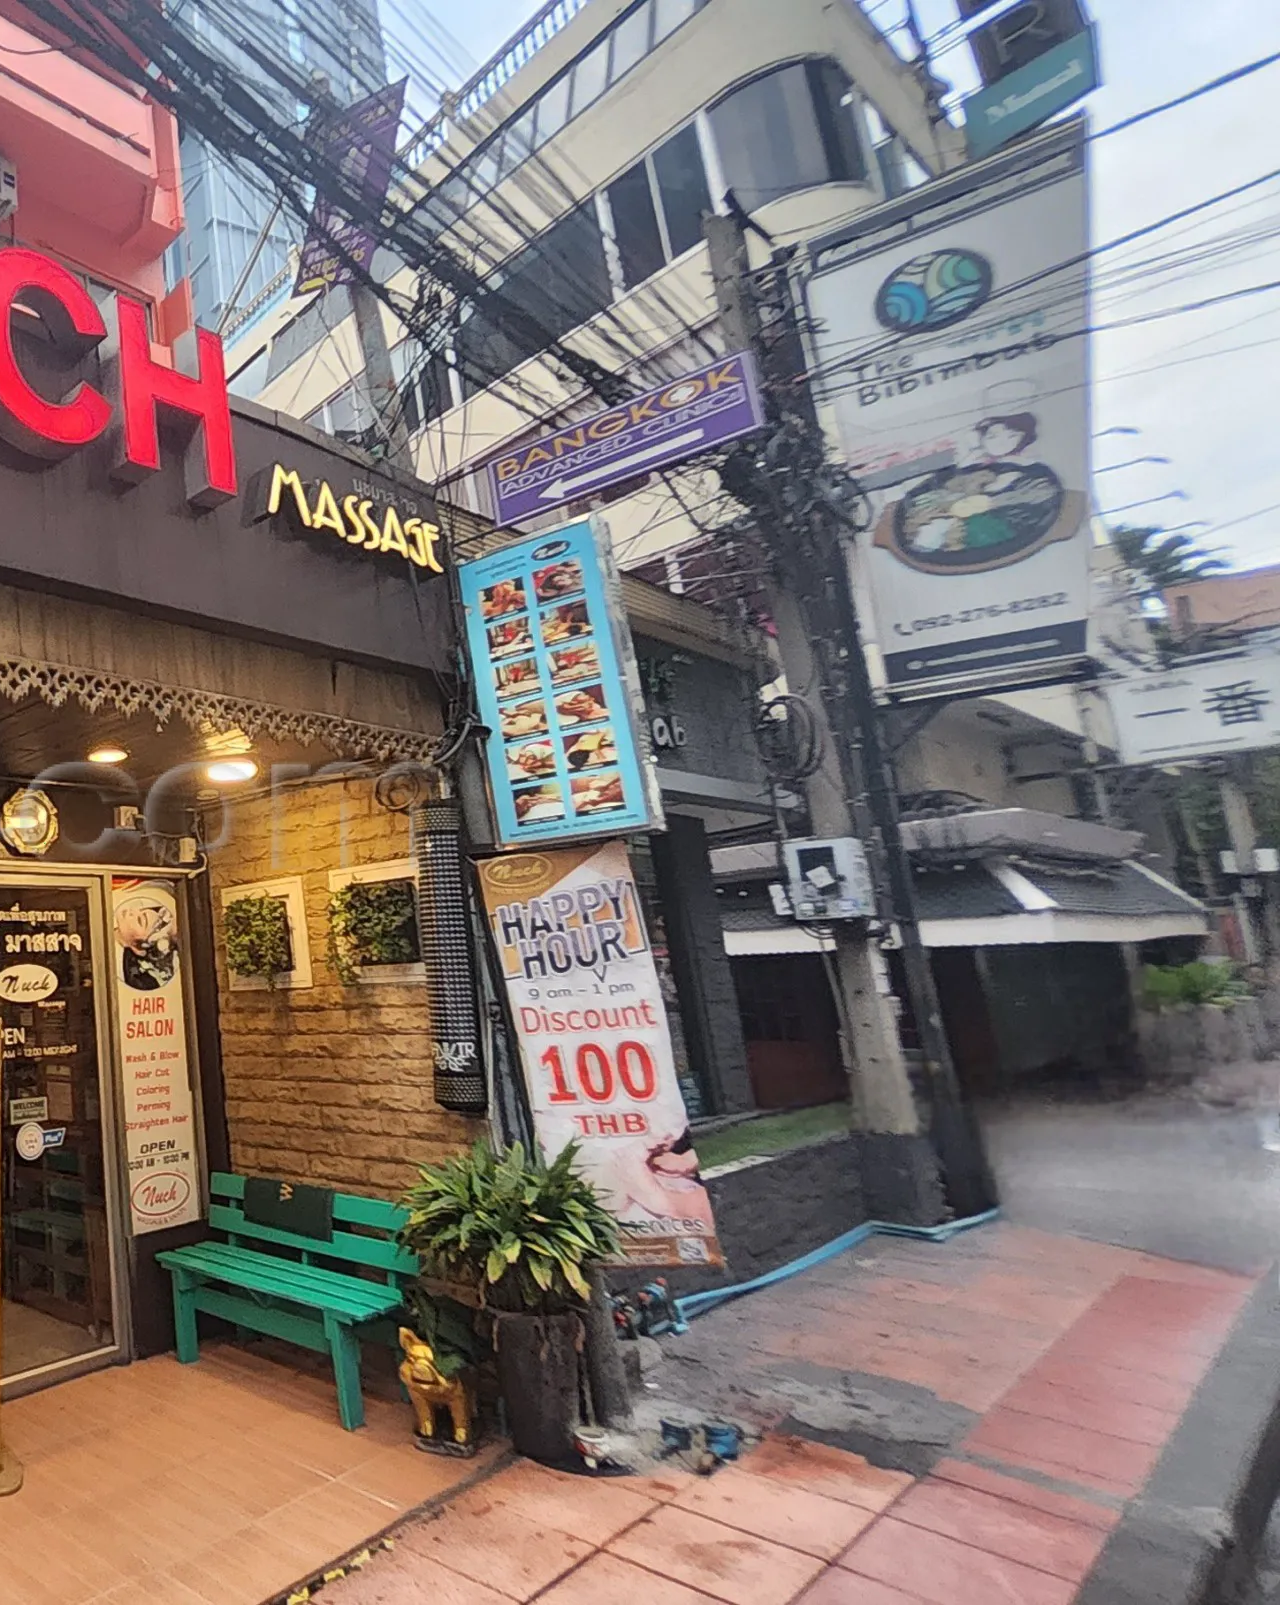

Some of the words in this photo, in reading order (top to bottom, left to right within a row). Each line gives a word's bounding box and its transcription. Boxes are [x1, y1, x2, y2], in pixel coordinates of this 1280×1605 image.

[497, 361, 741, 481] BANGKOK
[502, 434, 633, 494] ADVANCED
[268, 463, 444, 573] MASSAGE
[497, 878, 627, 947] HAPPY
[520, 920, 629, 980] HOUR
[528, 988, 540, 1000] 9
[547, 986, 573, 999] am
[608, 981, 637, 997] pm
[132, 997, 166, 1016] HAIR
[520, 998, 658, 1035] Discount
[126, 1019, 175, 1040] SALON
[125, 1053, 147, 1063] Wash
[160, 1050, 180, 1060] Blow
[135, 1070, 152, 1080] Hair
[155, 1068, 170, 1077] Cut
[540, 1040, 656, 1103] 100
[136, 1084, 170, 1096] Coloring
[137, 1100, 171, 1112] Perming
[124, 1117, 170, 1132] Straighten
[172, 1112, 189, 1123] Hair
[574, 1111, 648, 1136] THB
[140, 1139, 176, 1154] OPEN
[142, 1181, 177, 1207] Nuch
